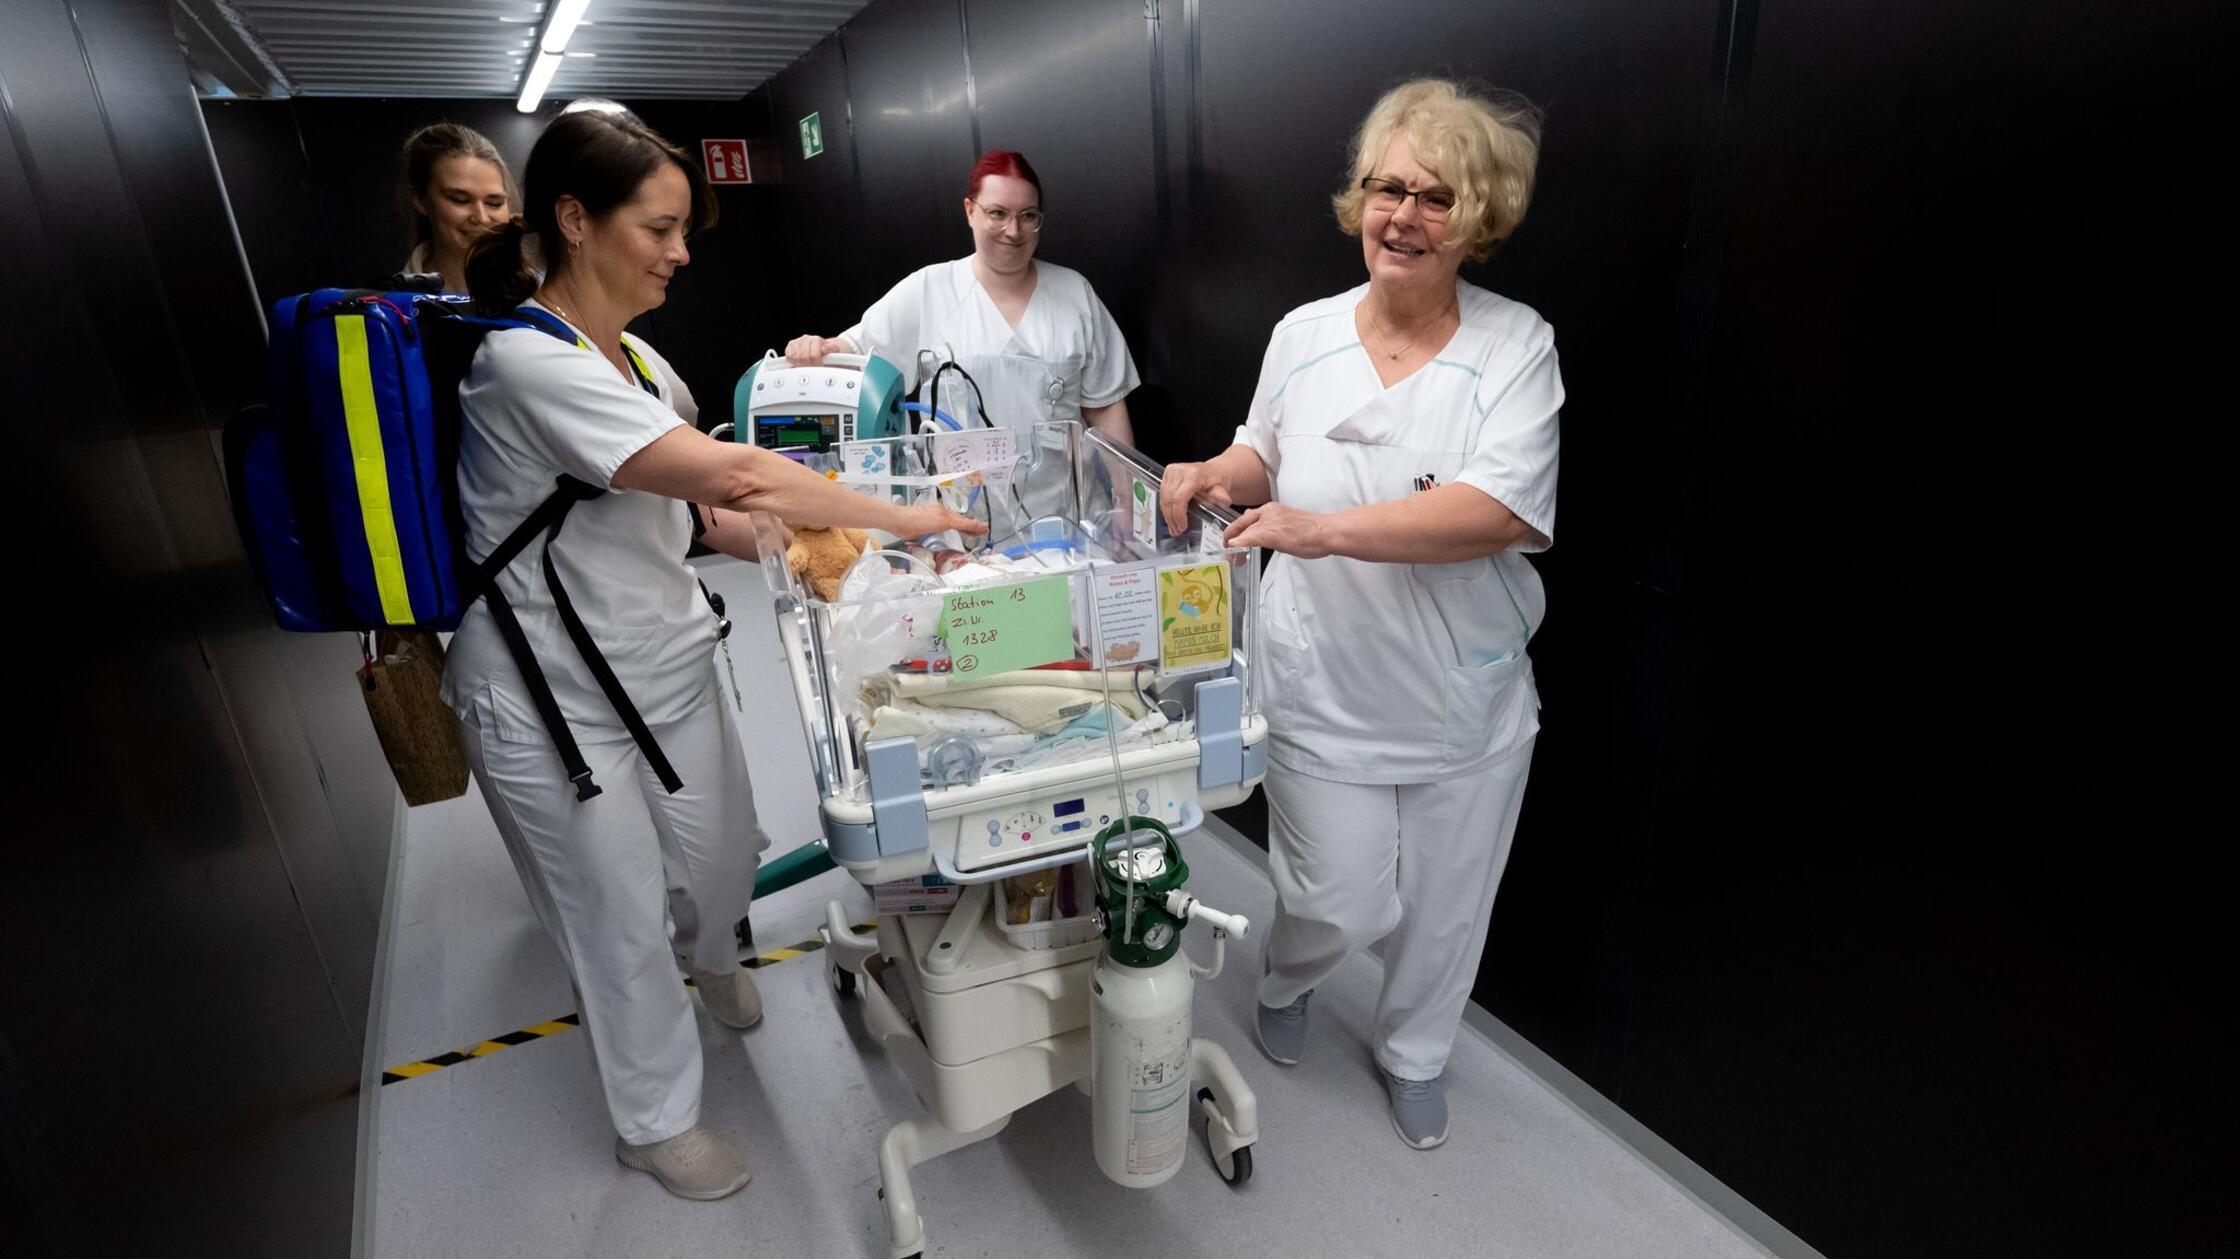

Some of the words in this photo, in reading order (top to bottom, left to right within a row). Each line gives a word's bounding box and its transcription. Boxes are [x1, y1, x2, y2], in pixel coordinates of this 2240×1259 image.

[951, 595, 994, 611] Station
[1010, 587, 1026, 601] 13
[962, 629, 998, 646] 1328
